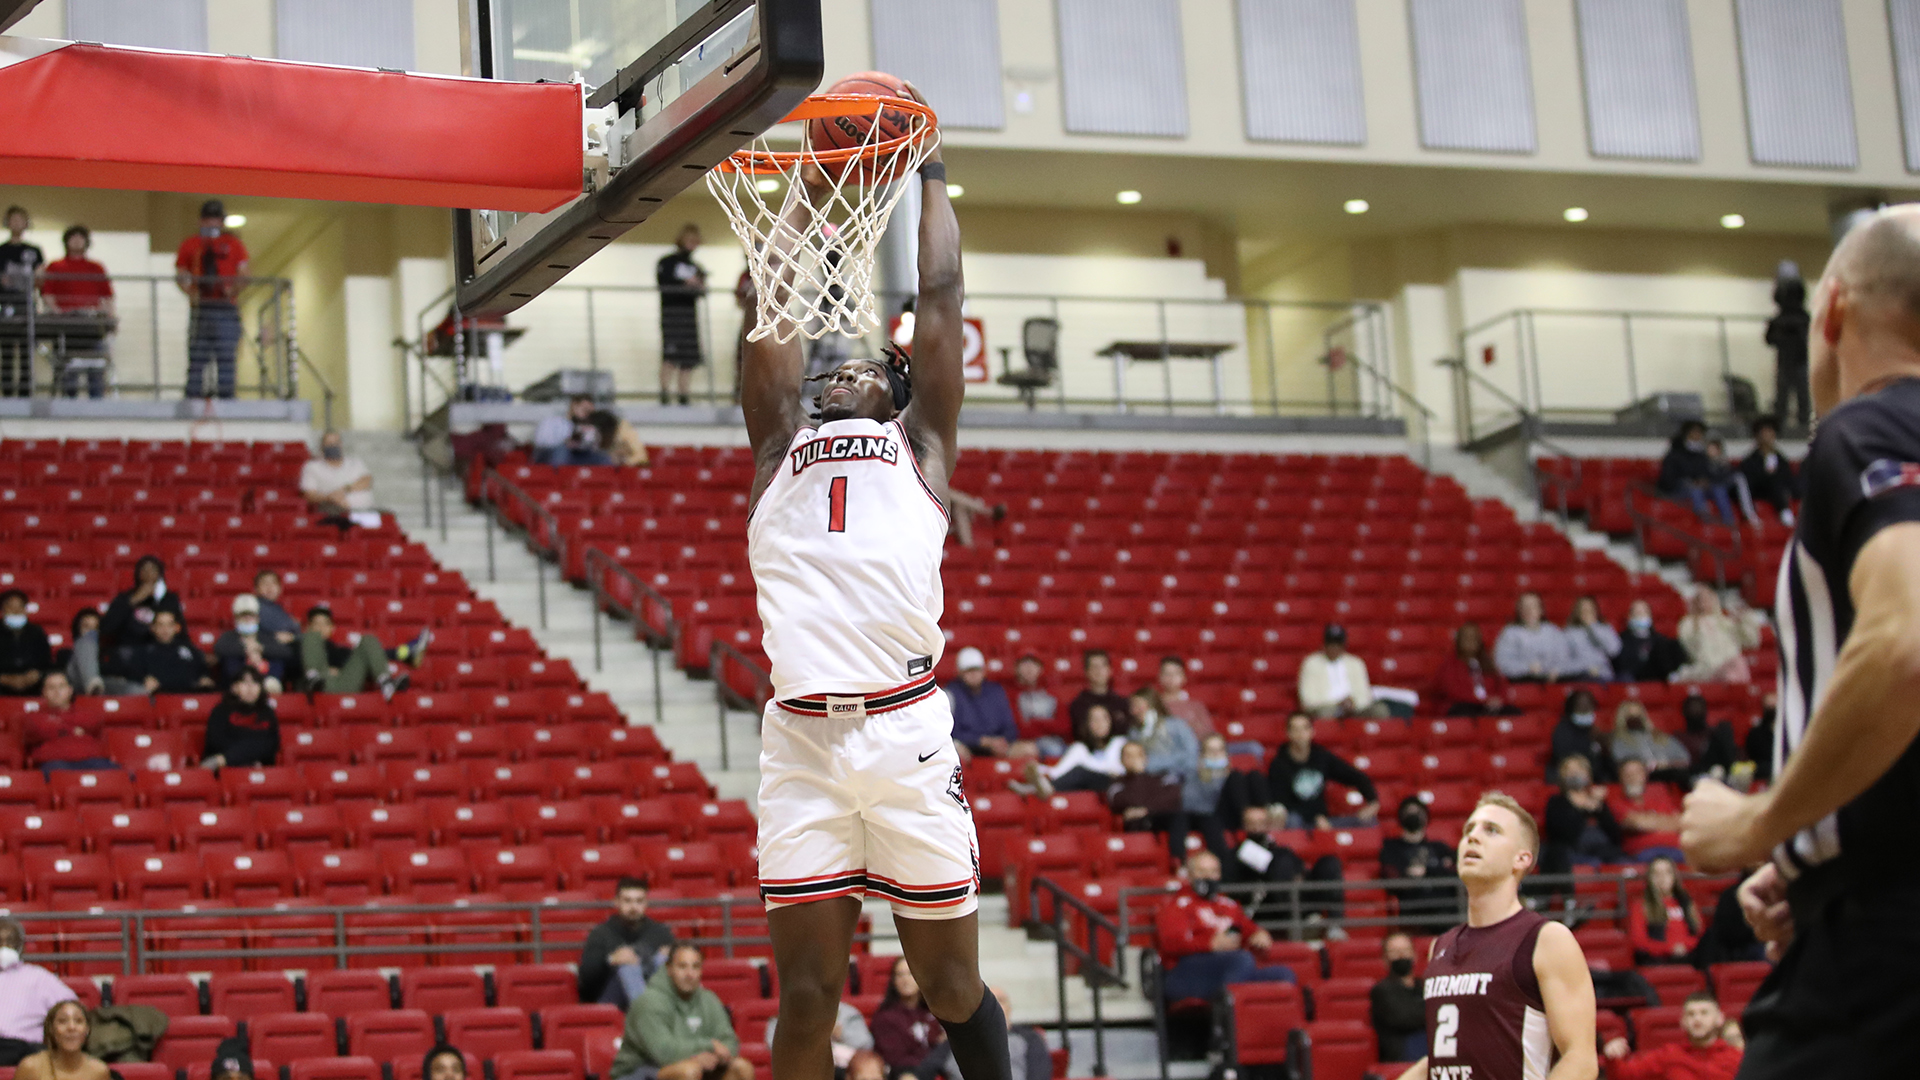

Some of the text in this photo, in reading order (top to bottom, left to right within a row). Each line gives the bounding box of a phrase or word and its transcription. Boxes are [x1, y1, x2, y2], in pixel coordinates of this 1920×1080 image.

[791, 435, 899, 475] VULCANS
[828, 476, 848, 533] 1
[1433, 1003, 1460, 1058] 2
